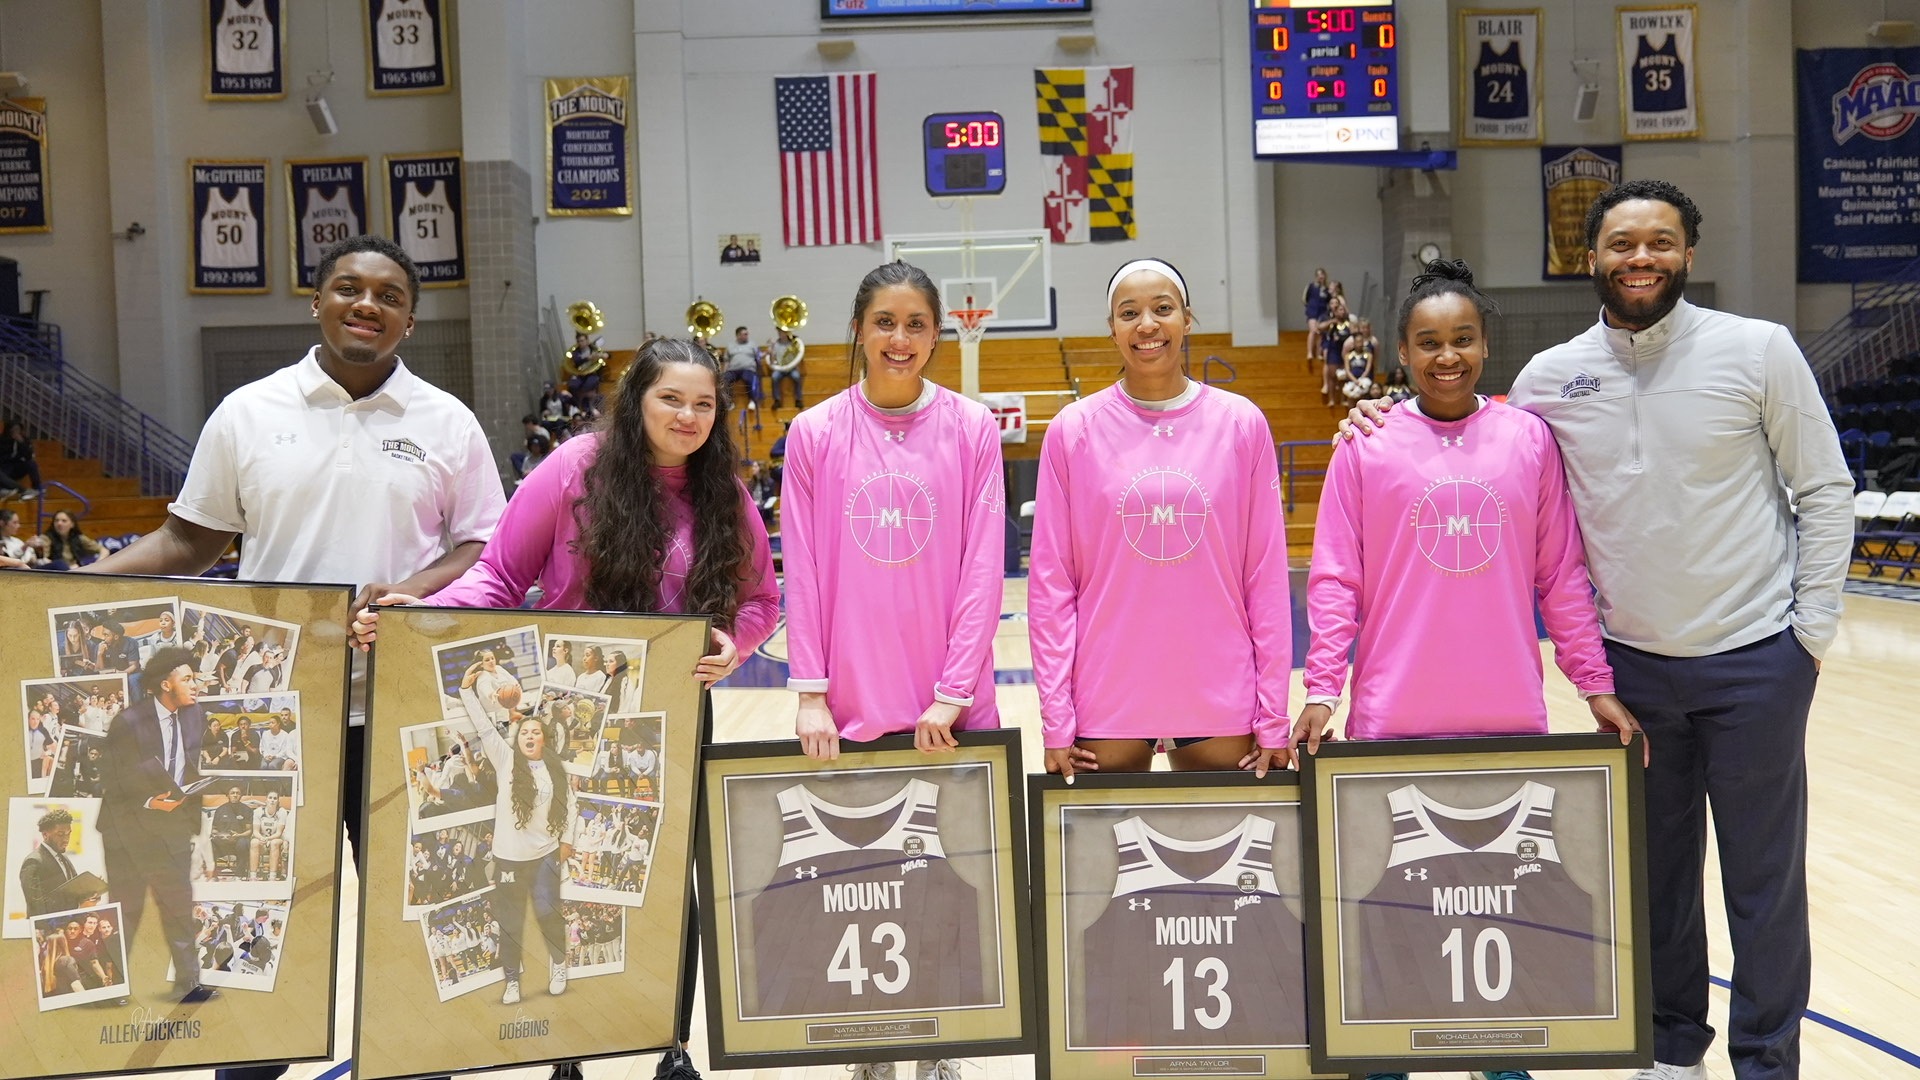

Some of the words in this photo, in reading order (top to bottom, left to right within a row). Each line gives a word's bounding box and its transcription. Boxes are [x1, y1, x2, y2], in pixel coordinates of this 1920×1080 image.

[227, 15, 263, 27] MOUNT
[386, 10, 423, 22] MOUNT
[1257, 14, 1283, 25] Home
[1307, 9, 1355, 33] 5:00
[1630, 15, 1685, 30] ROWLYK
[392, 25, 420, 45] 33
[1379, 24, 1395, 48] 0
[1478, 20, 1523, 36] BLAIR
[232, 30, 259, 49] 32
[1273, 27, 1289, 51] 0
[1311, 46, 1340, 57] period
[1350, 43, 1357, 59] 1
[1639, 54, 1677, 68] MOUNT
[1481, 63, 1521, 77] MOUNT
[1374, 78, 1387, 97] 0
[1645, 69, 1672, 92] 35
[1269, 81, 1282, 100] 0
[1487, 80, 1514, 103] 24
[552, 98, 577, 119] THE
[580, 96, 622, 118] MOUNT
[566, 130, 610, 140] NORTHEAST
[945, 121, 999, 148] 5:00
[1355, 127, 1391, 141] PNC
[562, 143, 613, 153] CONFERENCE
[561, 155, 615, 166] TOURNAMENT
[1823, 157, 1867, 170] Canisius
[195, 169, 264, 183] McGUTHRIE
[302, 166, 353, 183] PHELAN
[394, 162, 455, 179] O'REILLY
[557, 168, 620, 184] CHAMPIONS
[1548, 161, 1573, 182] THE
[1575, 160, 1616, 182] MOUNT
[1840, 171, 1893, 183] Manhattan
[571, 189, 608, 200] 2021
[1818, 185, 1854, 198] Mount
[1856, 185, 1869, 197] St.
[1872, 185, 1906, 199] Mary's
[312, 208, 348, 219] MOUNT
[409, 203, 445, 216] MOUNT
[1842, 199, 1898, 212] Quinnipiac
[211, 209, 248, 221] MOUNT
[1834, 213, 1864, 226] Saint
[1866, 212, 1902, 225] Peter's
[216, 224, 242, 244] 50
[313, 222, 349, 244] 830
[416, 219, 439, 239] 51
[1562, 381, 1574, 394] THE
[1576, 378, 1599, 389] MOUNT
[1570, 390, 1590, 399] BASKETBALL
[383, 440, 399, 451] THE
[400, 442, 424, 461] MOUNT
[878, 507, 903, 528] M
[1149, 504, 1177, 526] M
[1444, 515, 1472, 536] M
[901, 859, 928, 876] MAAC
[1513, 863, 1542, 880] MAAC
[500, 871, 516, 883] M
[823, 880, 904, 913] MOUNT
[1234, 895, 1261, 911] MAAC
[1432, 885, 1517, 916] MOUNT
[1155, 915, 1237, 946] MOUNT
[827, 921, 911, 996] 43
[1441, 927, 1513, 1003] 10
[1163, 956, 1232, 1031] 13
[499, 1020, 549, 1040] DOBBINS
[834, 1026, 866, 1034] NATALIE
[867, 1024, 911, 1032] VILLAFLOR
[1480, 1032, 1523, 1040] HARRISON
